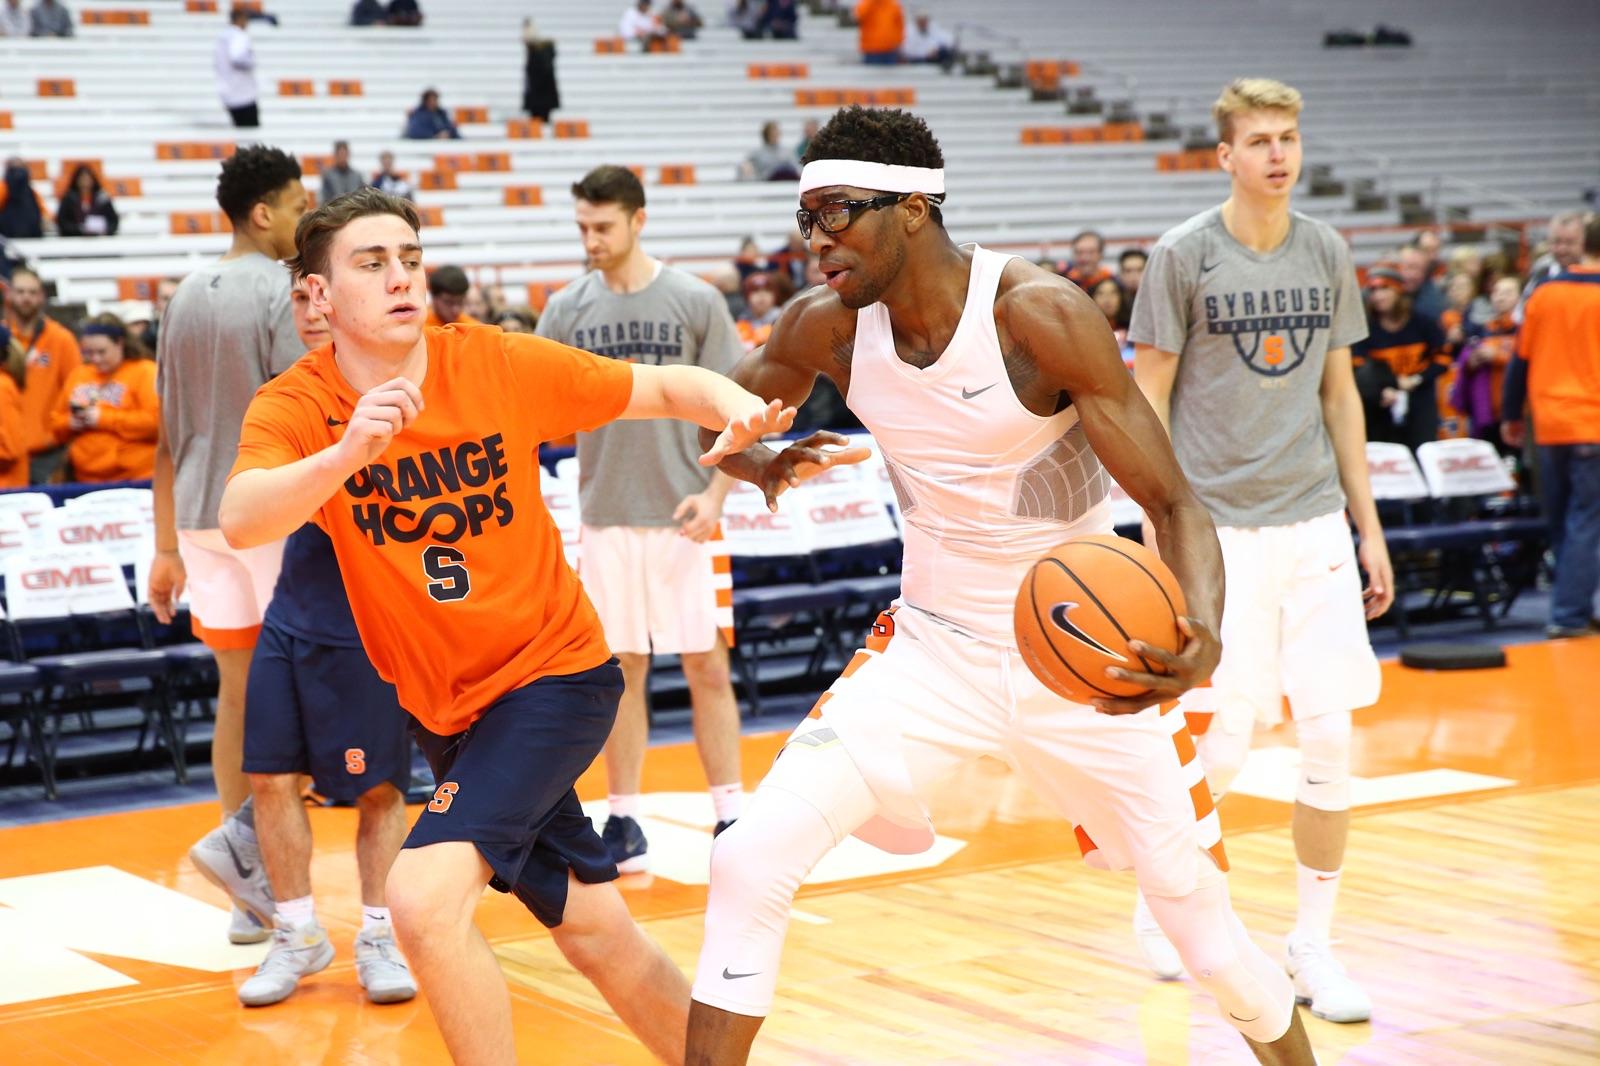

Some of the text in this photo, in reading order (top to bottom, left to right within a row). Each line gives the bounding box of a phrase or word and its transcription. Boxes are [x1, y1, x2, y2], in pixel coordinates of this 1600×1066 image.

[1205, 287, 1330, 319] SYRACUSE
[575, 320, 683, 348] SYRACUSE
[1263, 335, 1286, 366] S
[344, 432, 508, 503] ORANGE
[352, 482, 514, 546] HOOPS
[809, 501, 880, 525] GMC
[58, 521, 142, 545] GMC
[20, 565, 115, 591] GMC
[421, 545, 471, 603] S
[344, 748, 366, 774] S
[428, 781, 460, 813] S
